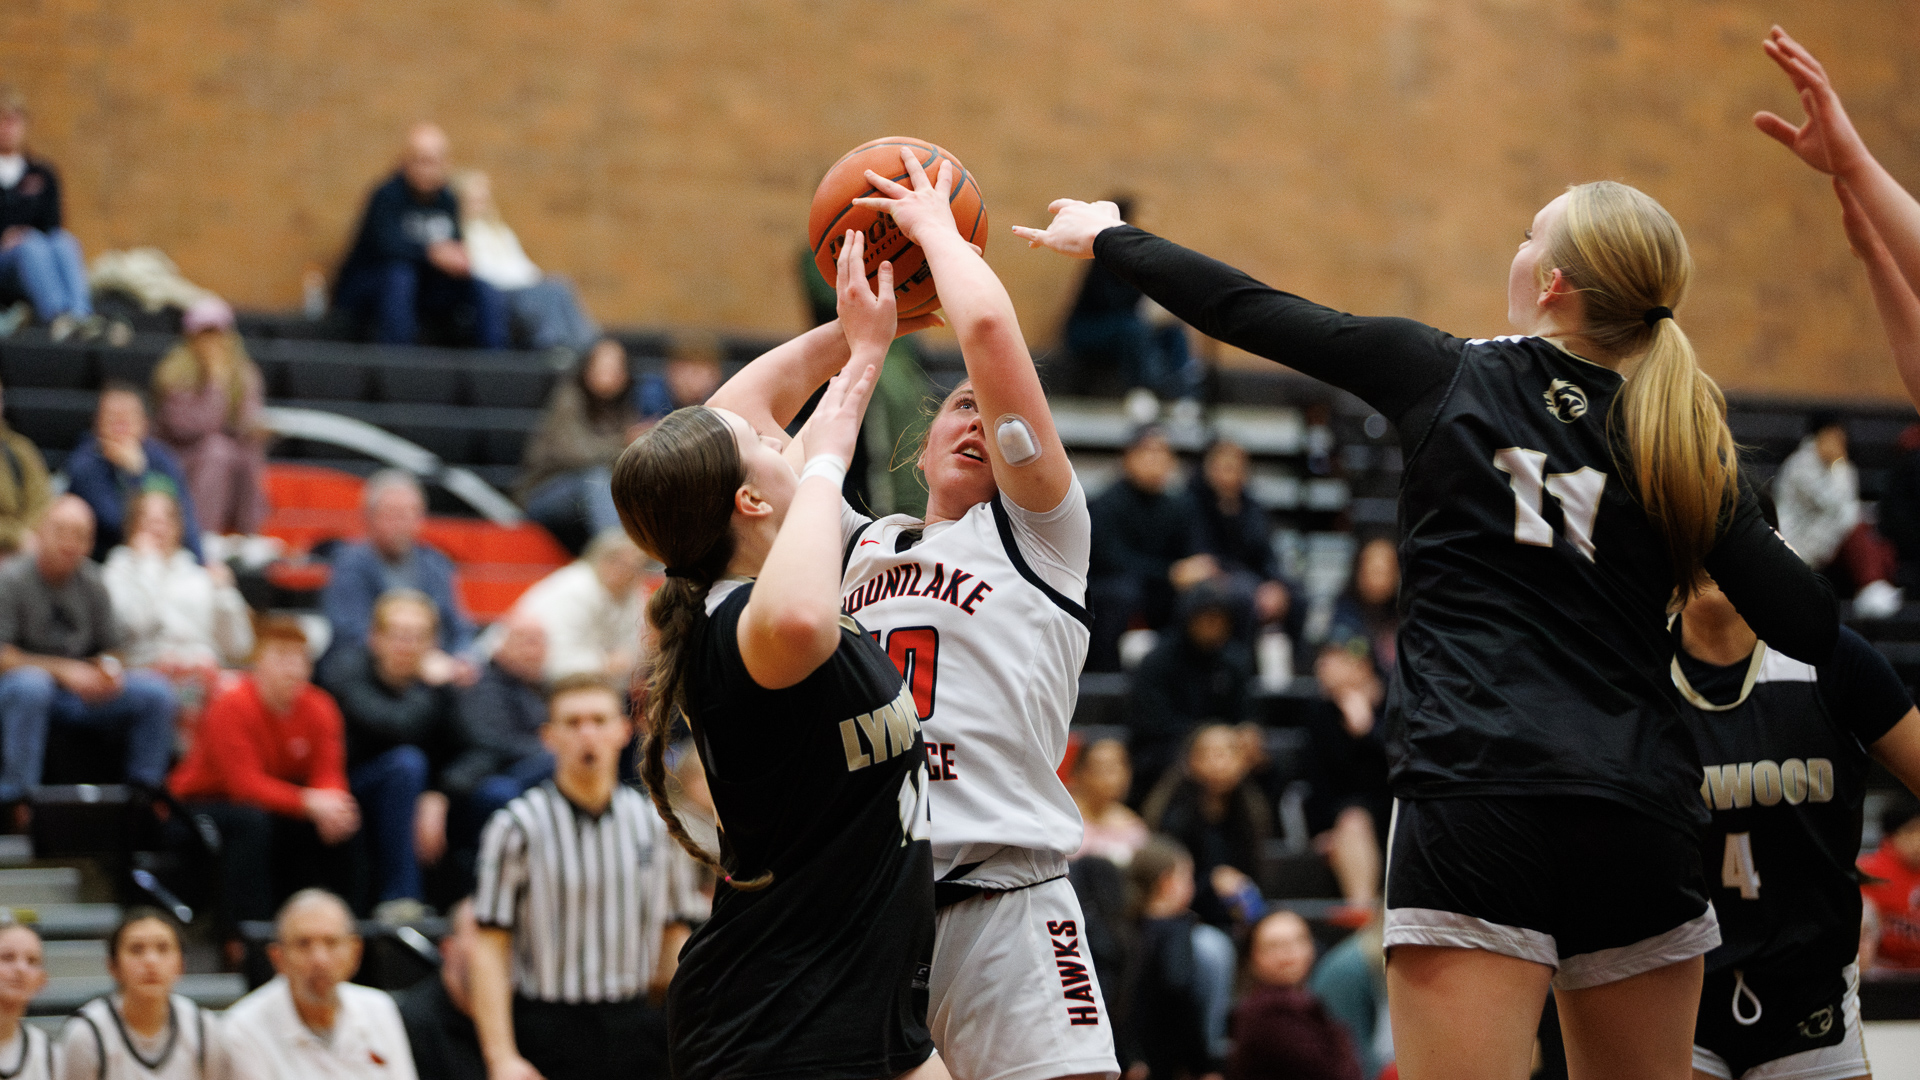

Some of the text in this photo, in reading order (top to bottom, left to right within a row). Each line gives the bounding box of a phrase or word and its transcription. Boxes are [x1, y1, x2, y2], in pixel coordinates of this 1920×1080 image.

[1493, 446, 1607, 564] 11
[843, 562, 993, 616] OUNTLAKE
[869, 625, 939, 722] 0
[1721, 831, 1761, 900] 4
[1046, 919, 1099, 1027] HAWKS
